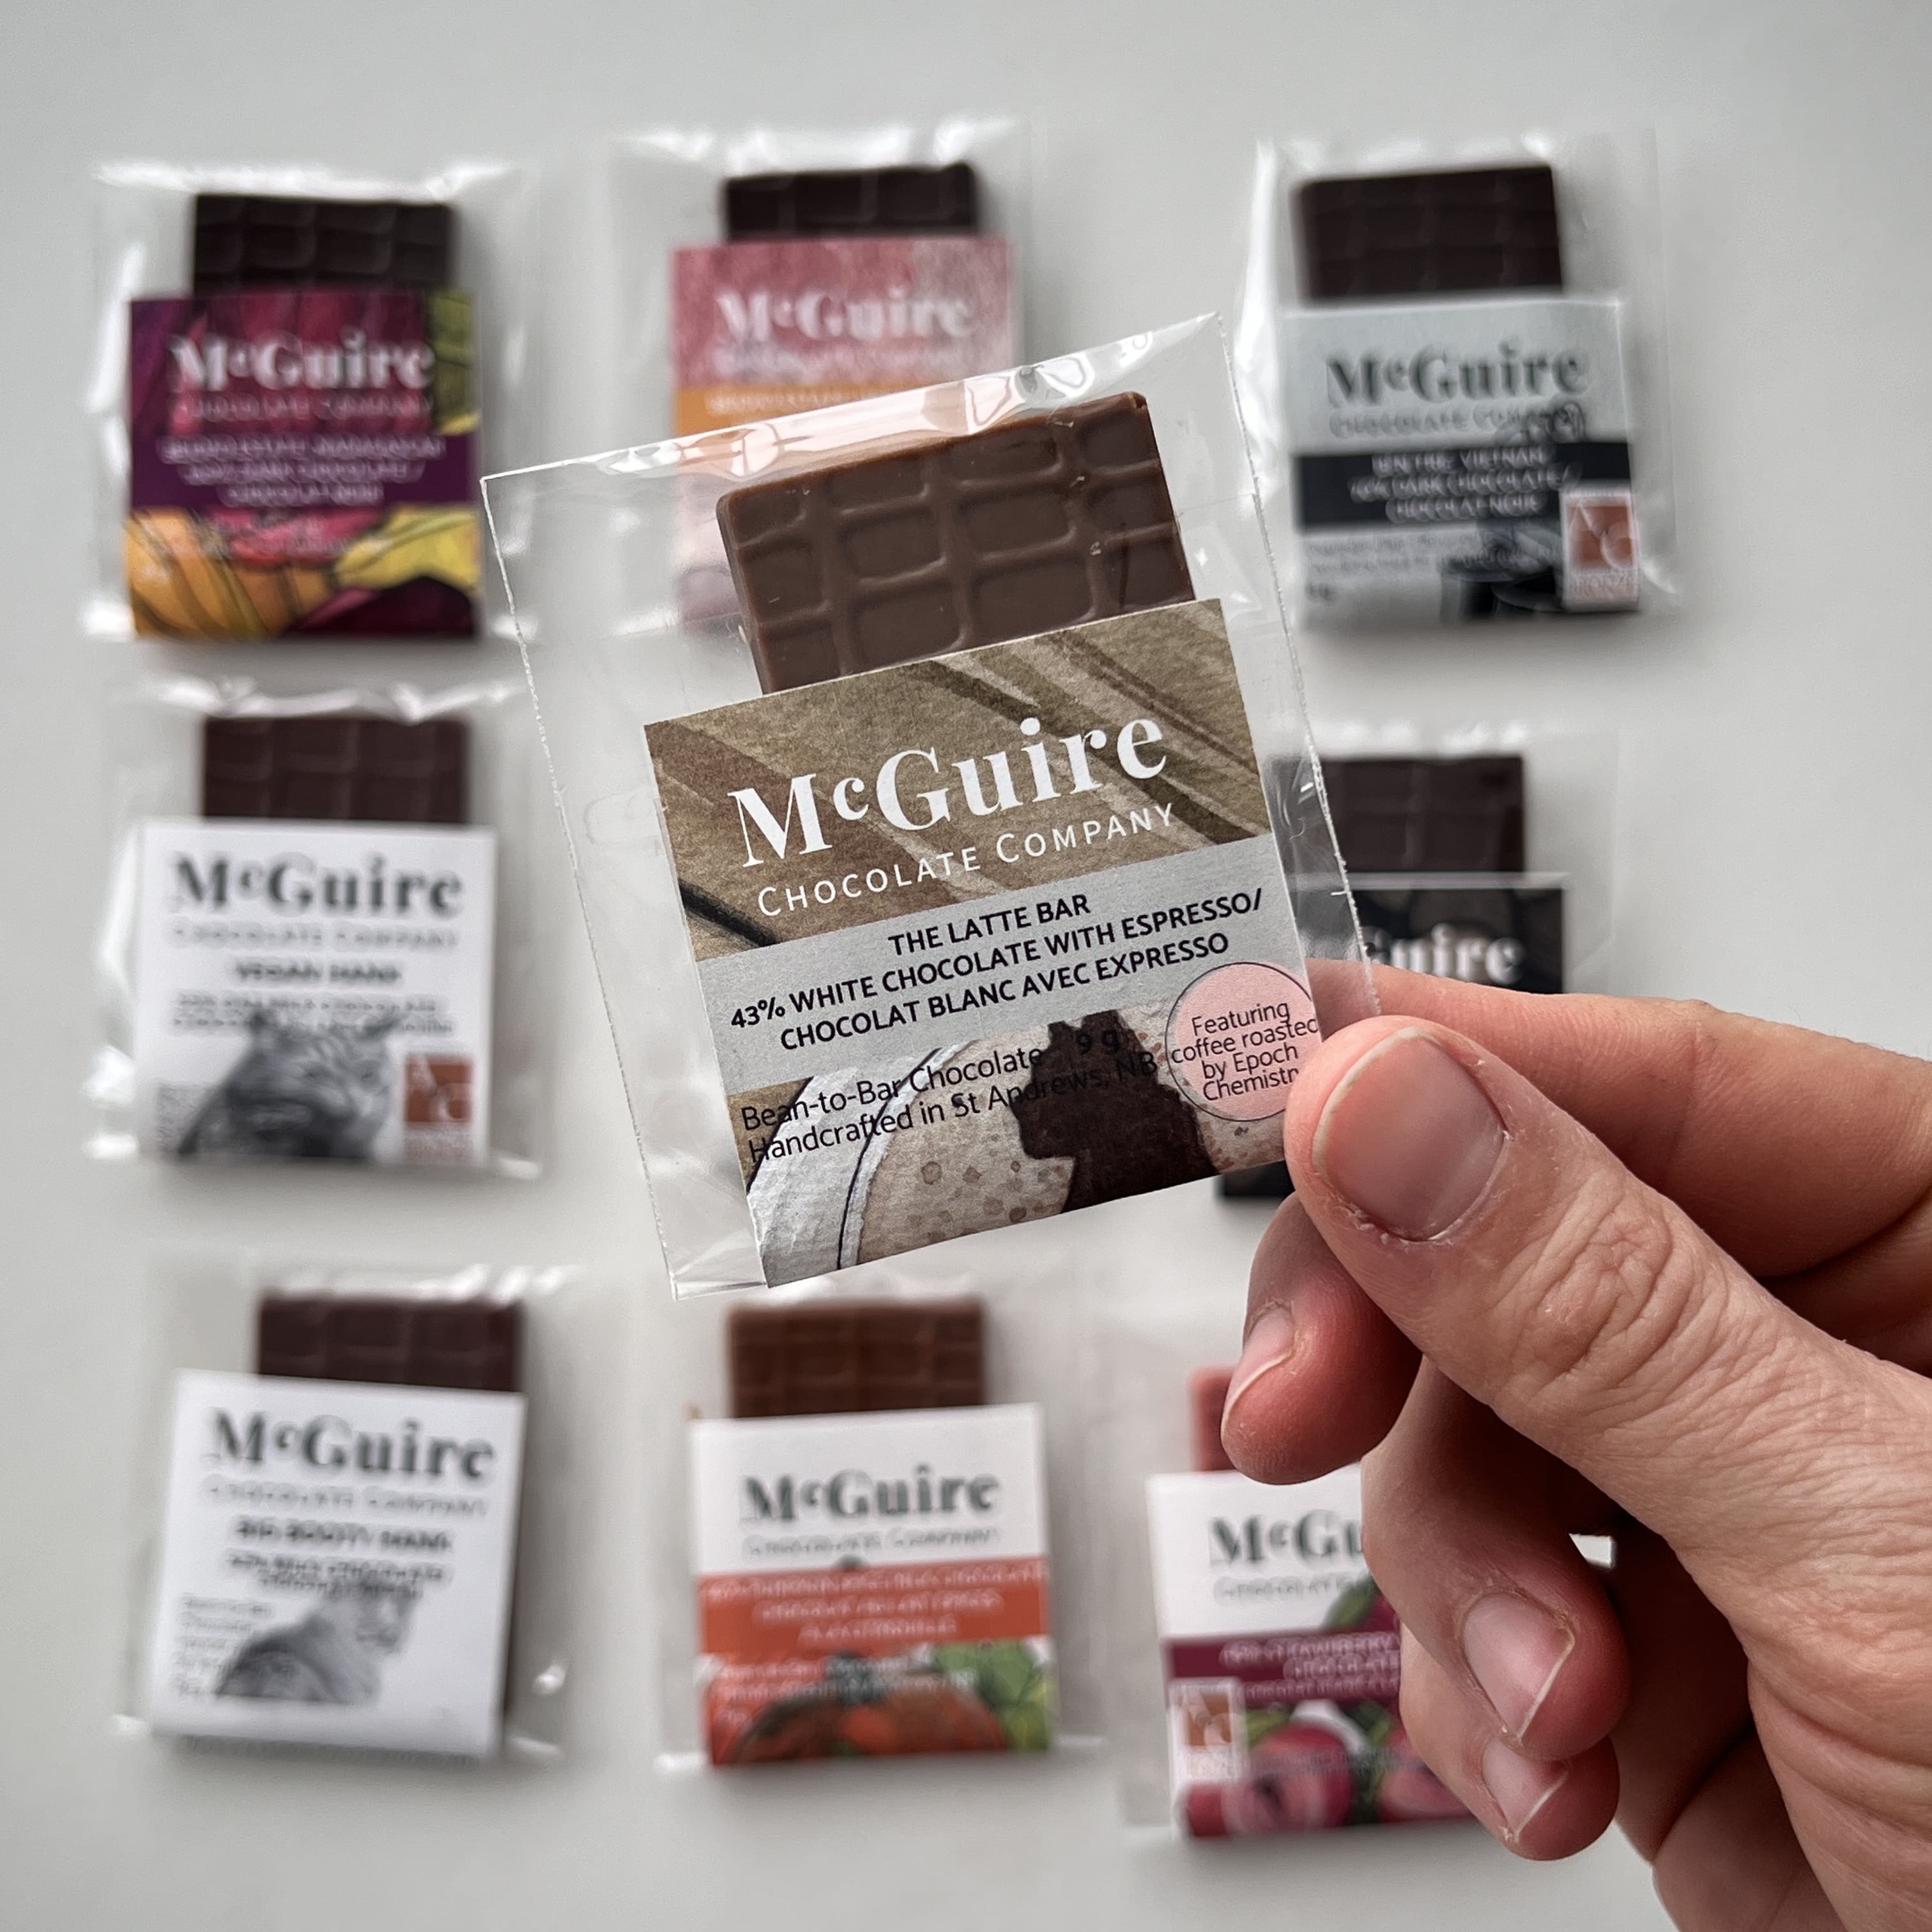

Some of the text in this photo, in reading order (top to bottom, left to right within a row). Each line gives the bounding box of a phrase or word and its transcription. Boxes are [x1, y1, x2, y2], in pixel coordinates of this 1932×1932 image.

[1326, 338, 1590, 407] McGuire
[727, 717, 1167, 868] McGuire
[172, 852, 463, 916] McGuire
[758, 802, 1172, 916] CHOCOLATE COMPANY
[730, 888, 1262, 1028] 43% WHITE CHOCOLATE WITH ESPRESSO/
[888, 894, 1091, 955] THE LATTE BAR
[781, 933, 1228, 1050] CHOCOLAT BLANC AVEC EXPRESSO
[1192, 1003, 1290, 1036] Featuring
[1172, 1037, 1236, 1063] coffee
[1202, 1042, 1299, 1082] by Epoch
[1203, 1068, 1299, 1101] Chemistr
[741, 1079, 901, 1131] Bean-to-Bar
[910, 1048, 1043, 1092] Chocolate
[749, 1105, 913, 1163] Handcrafted
[919, 1101, 945, 1124] in
[951, 1092, 981, 1117] St
[203, 1409, 496, 1480] McGuire
[740, 1464, 999, 1522] McGuire
